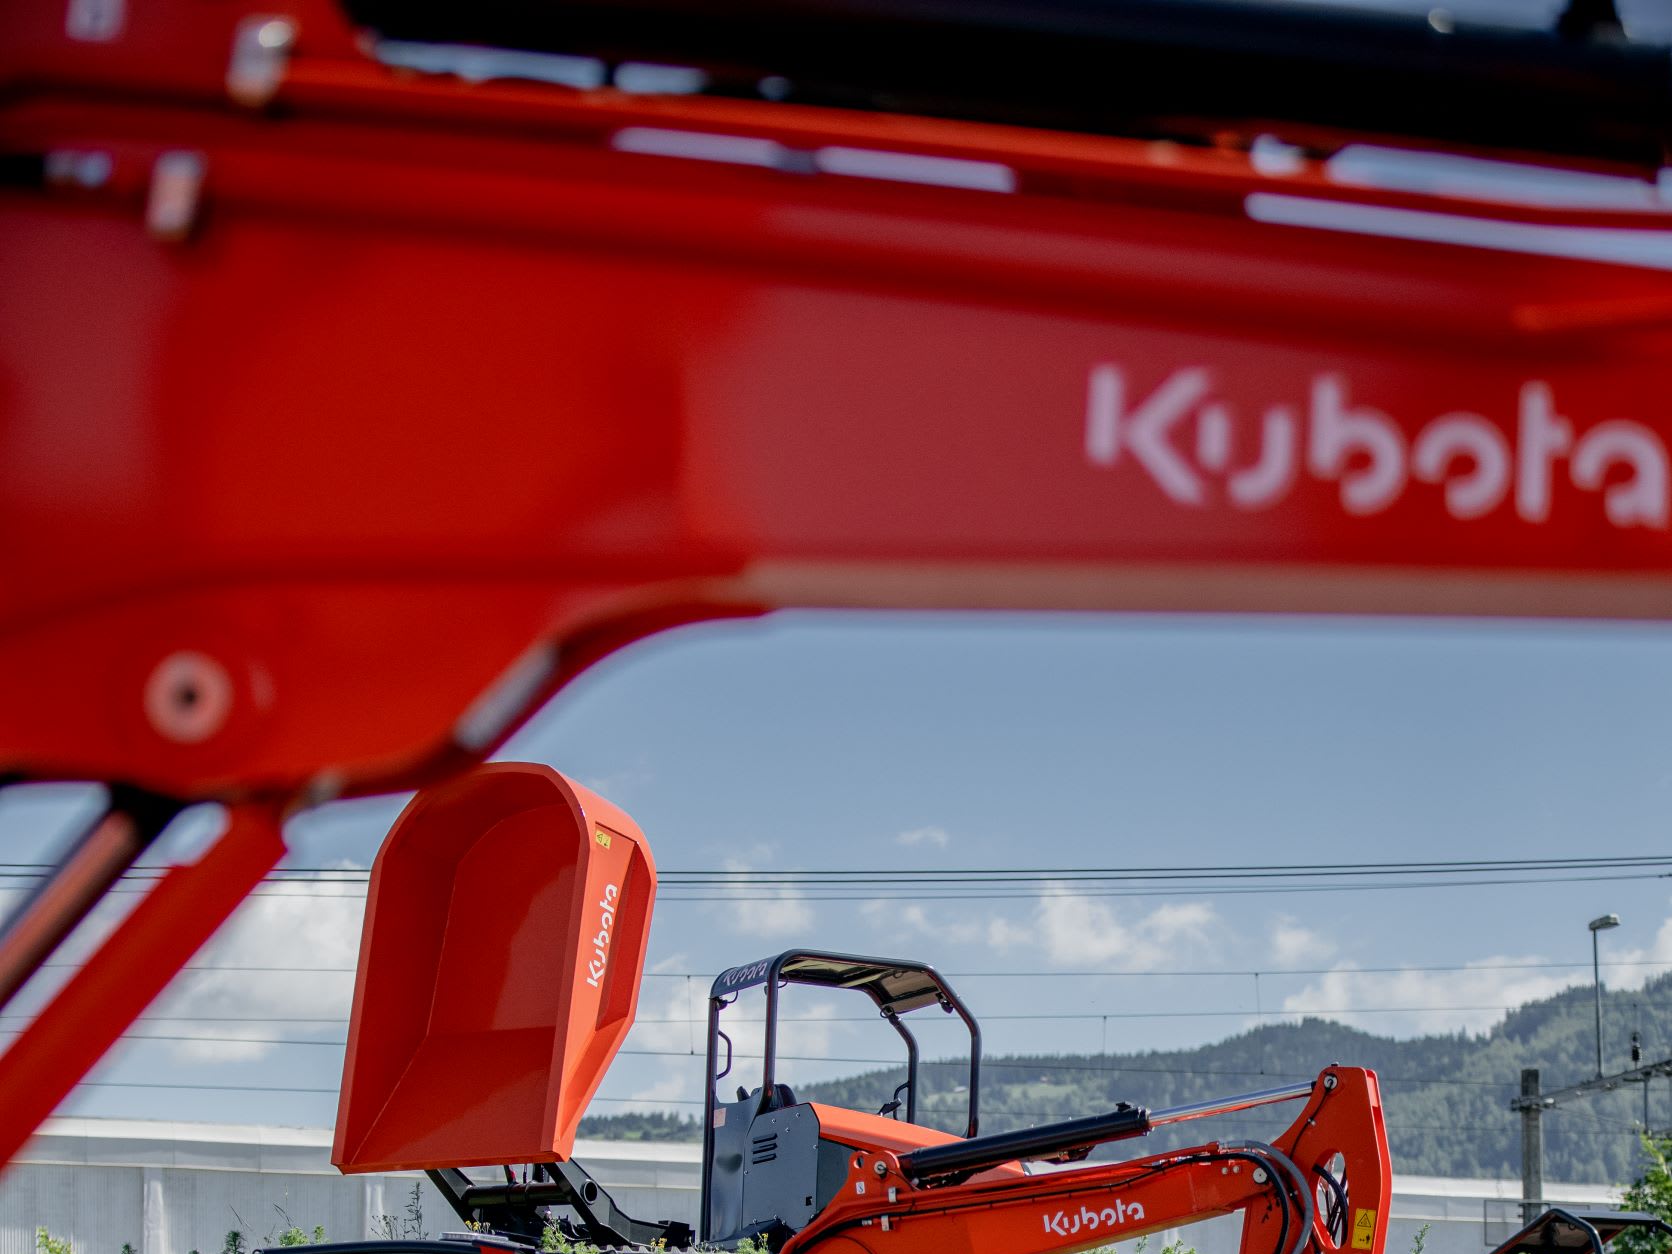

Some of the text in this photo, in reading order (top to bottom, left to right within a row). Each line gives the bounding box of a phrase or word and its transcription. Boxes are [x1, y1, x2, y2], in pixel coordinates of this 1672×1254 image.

[1086, 362, 1670, 528] Kubota
[586, 883, 618, 988] Kubota
[1043, 1198, 1145, 1236] Kubota
